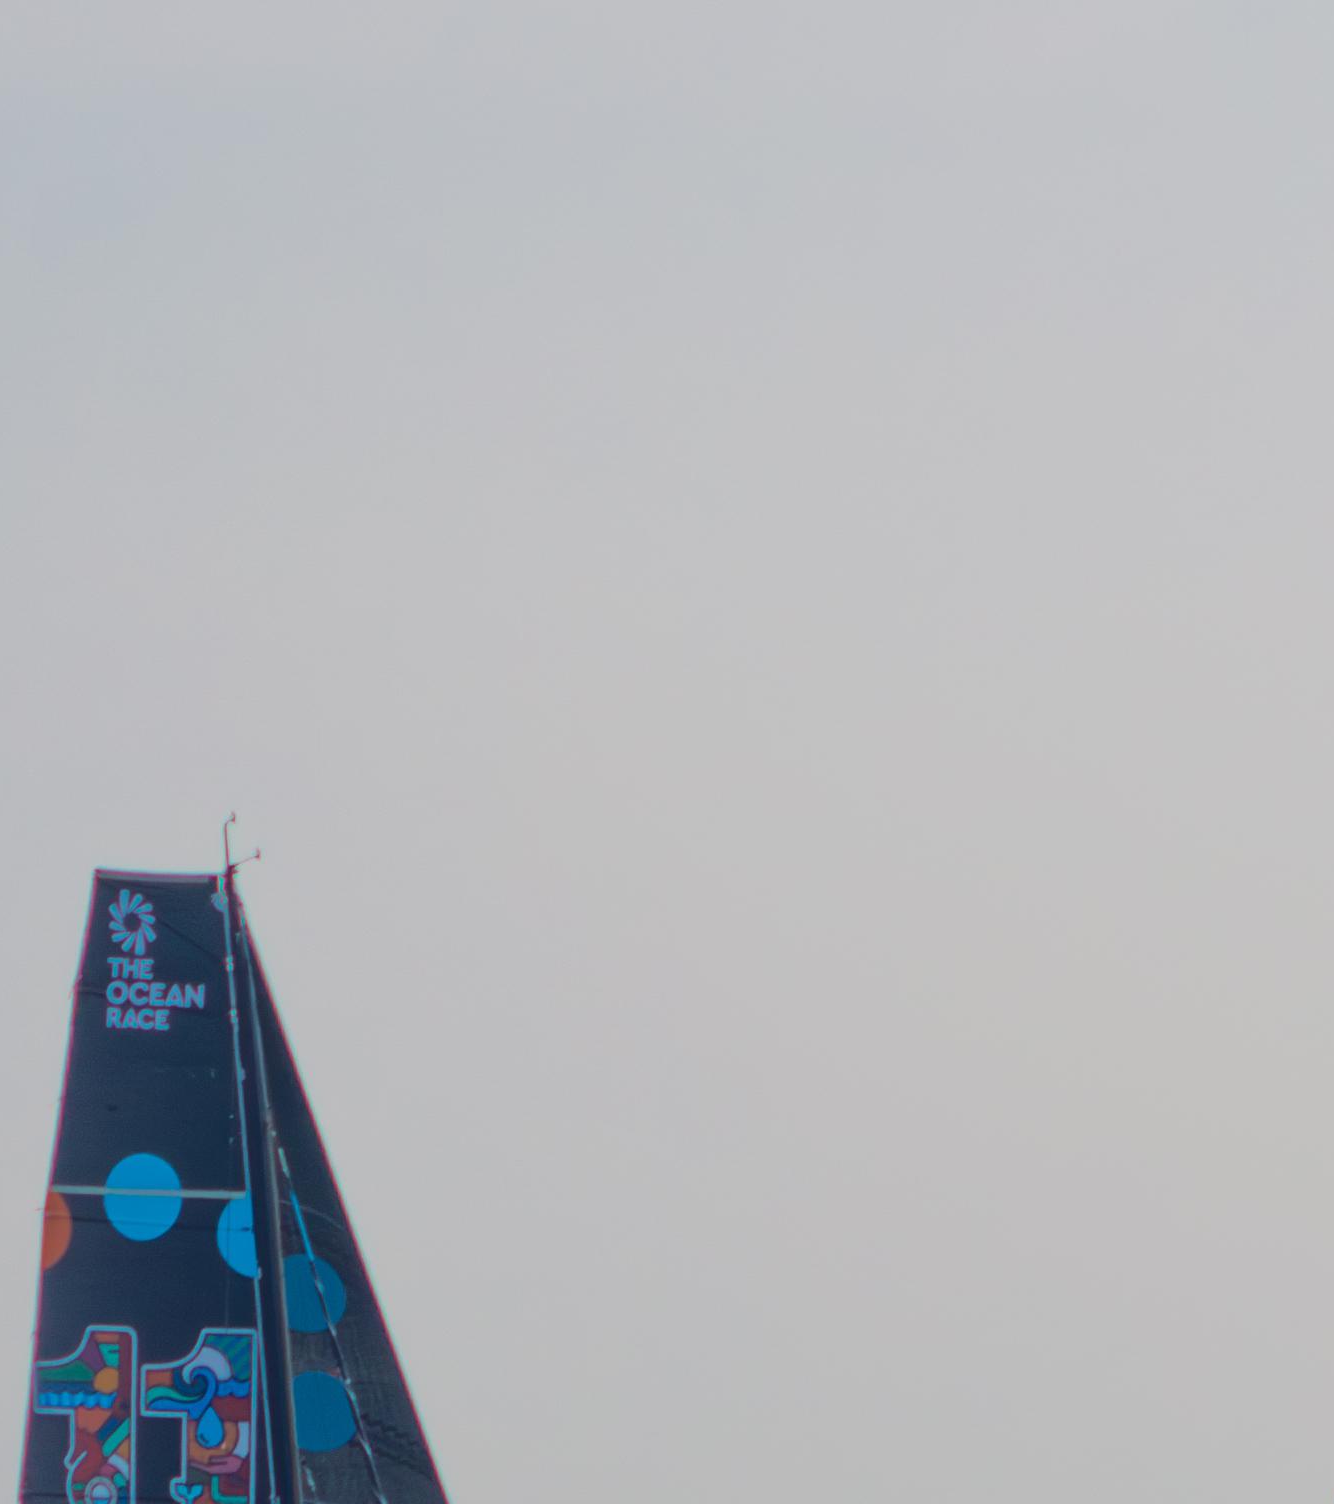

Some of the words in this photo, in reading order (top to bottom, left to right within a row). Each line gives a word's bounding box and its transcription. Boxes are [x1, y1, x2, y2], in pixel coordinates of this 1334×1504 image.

[107, 957, 154, 979] THE
[106, 982, 205, 1008] OCEAN
[106, 1007, 170, 1030] RACE
